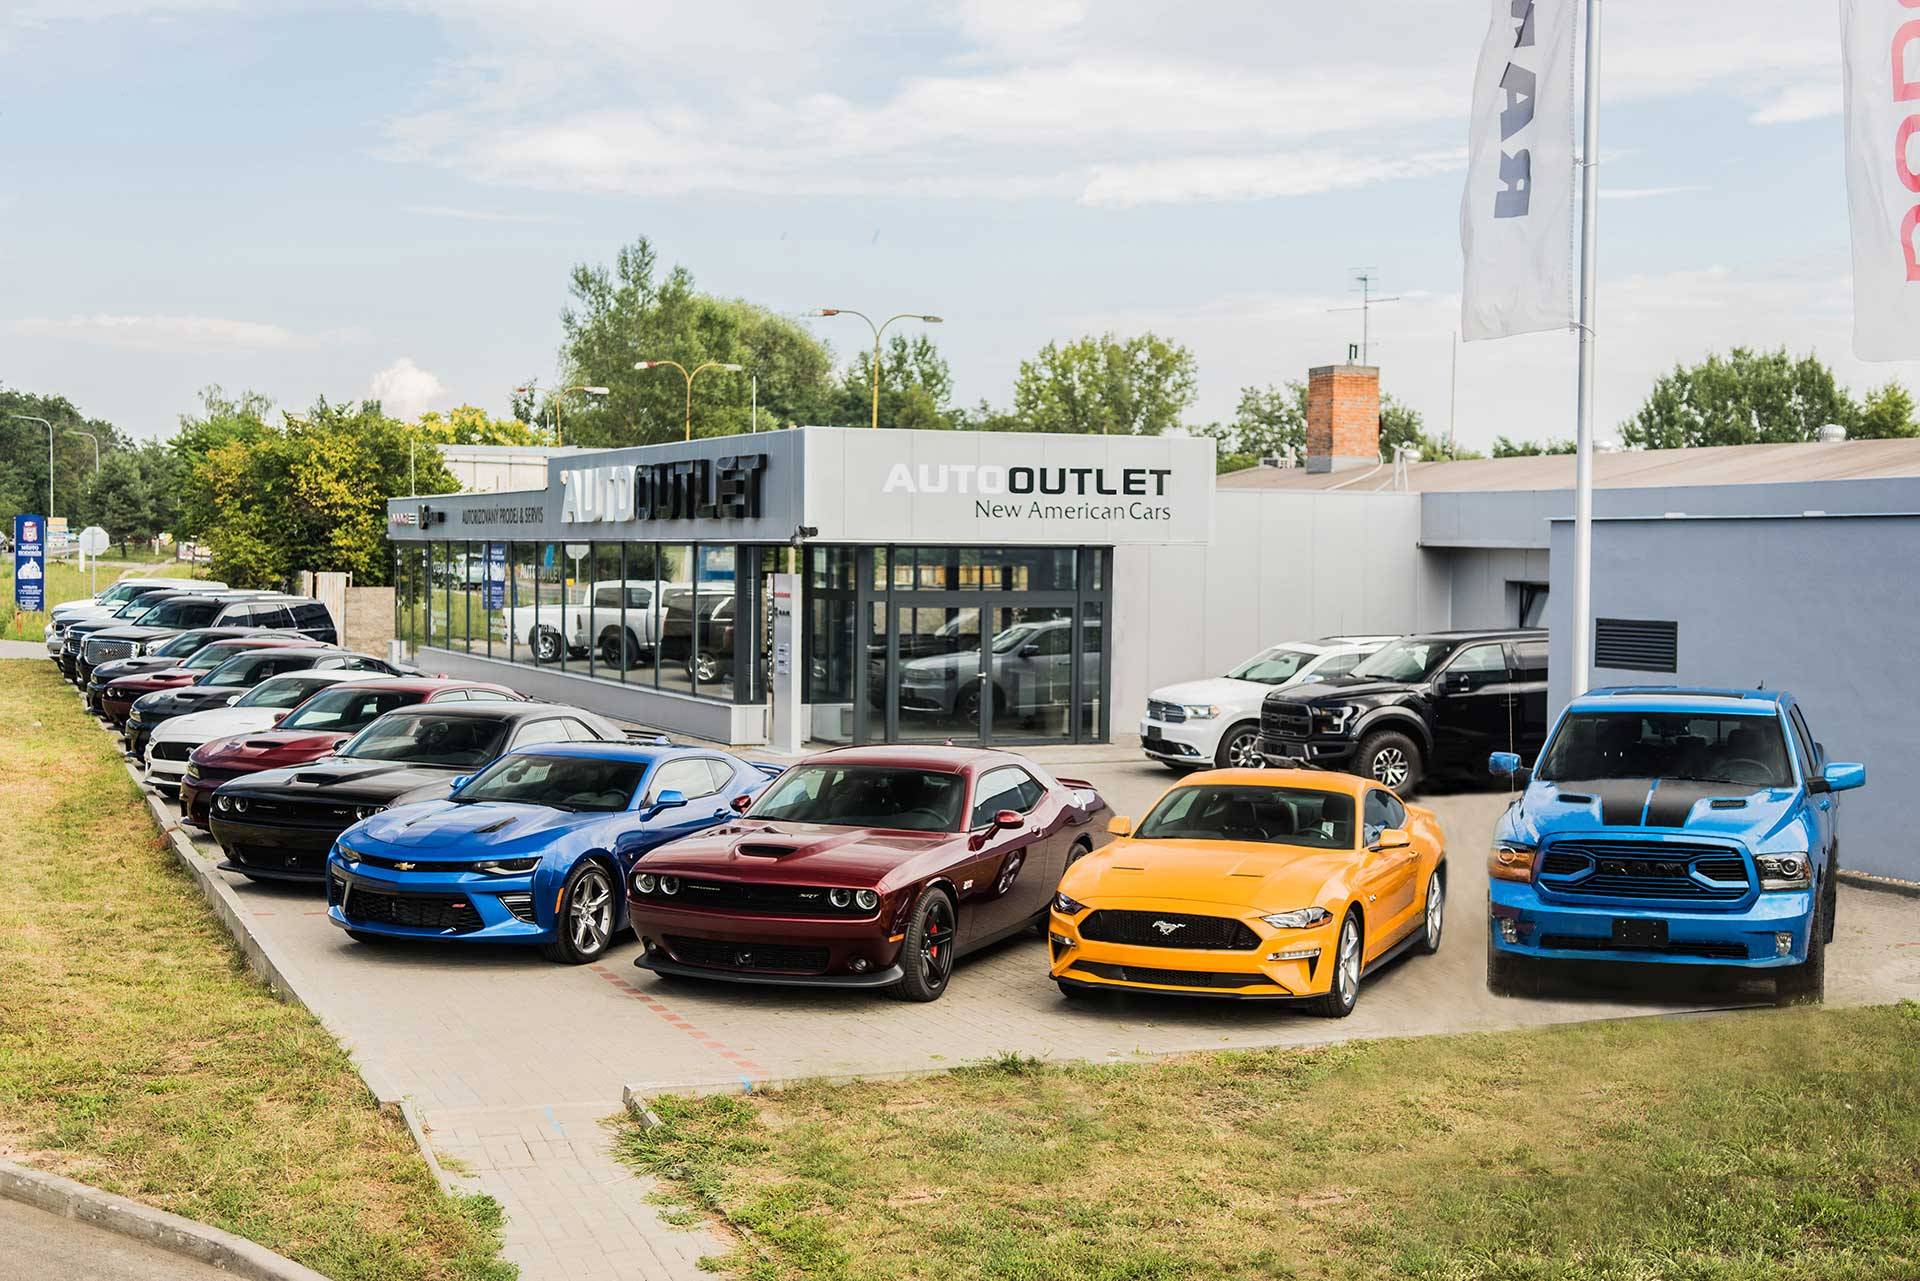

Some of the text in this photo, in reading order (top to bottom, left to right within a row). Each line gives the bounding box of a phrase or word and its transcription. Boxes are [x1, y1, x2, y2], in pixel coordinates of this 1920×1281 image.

[525, 506, 544, 524] SERVIS
[975, 500, 1171, 520] New American Cars
